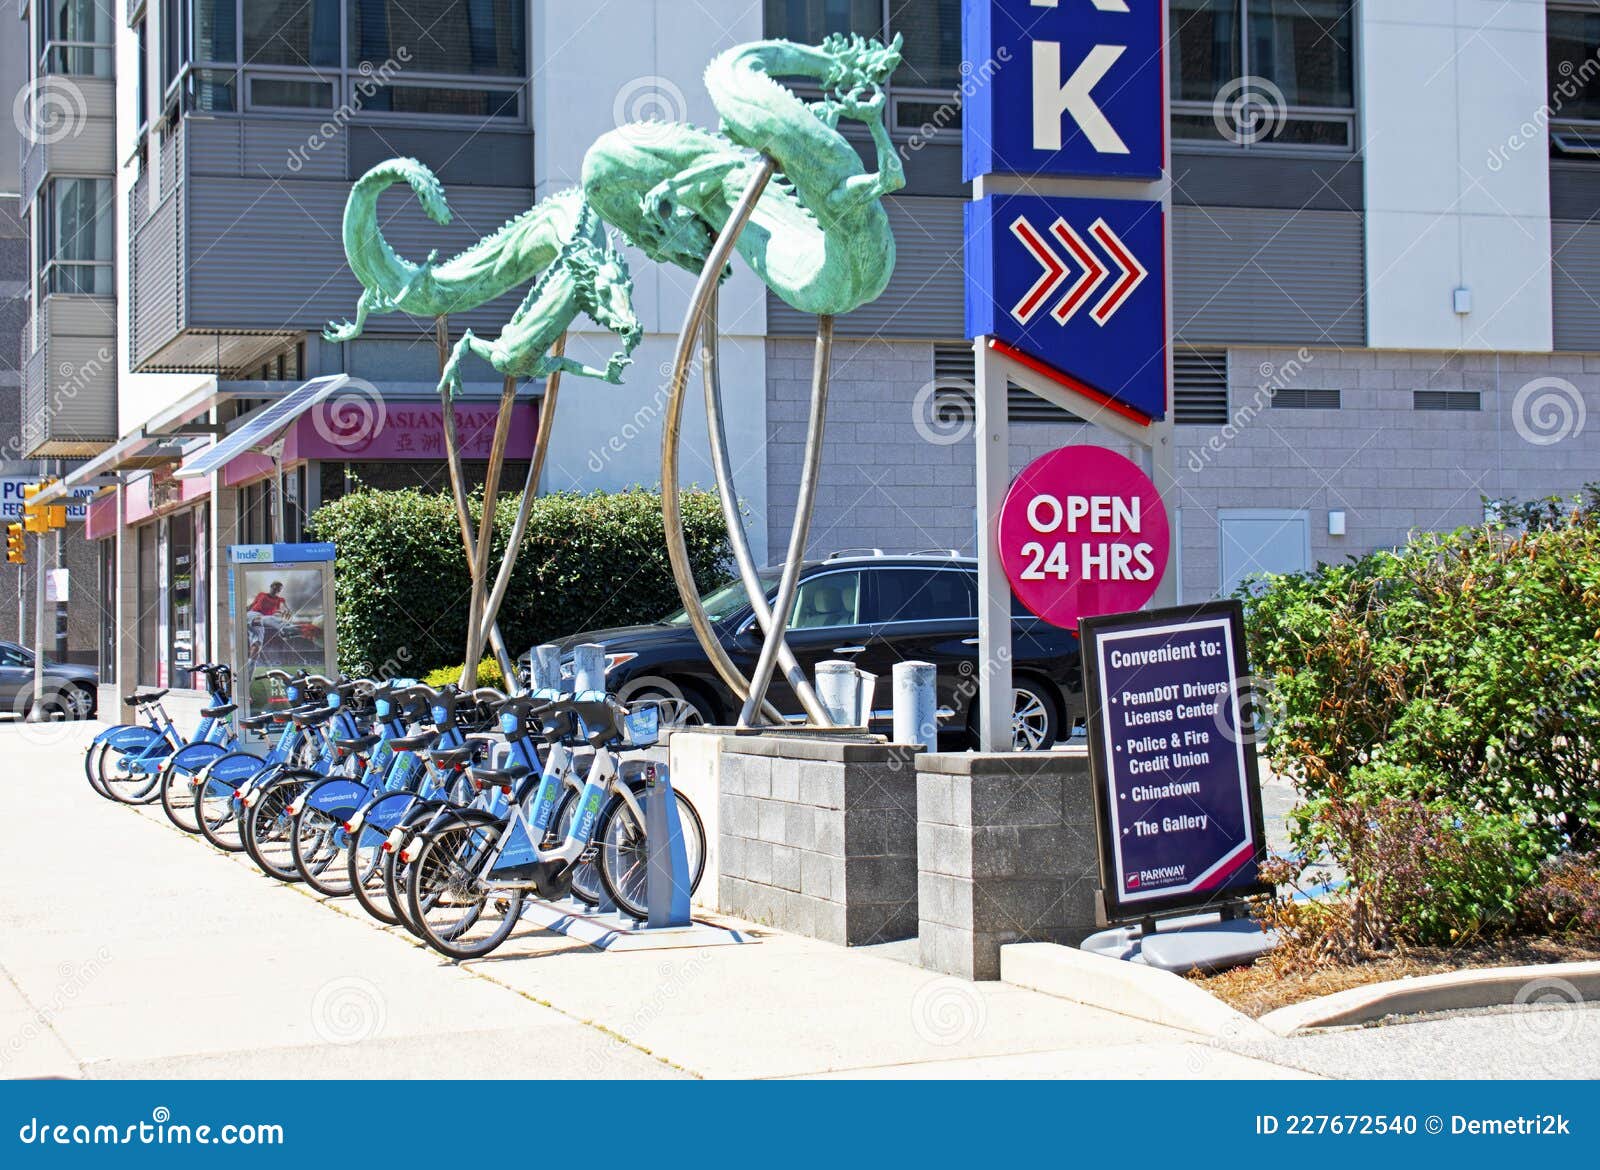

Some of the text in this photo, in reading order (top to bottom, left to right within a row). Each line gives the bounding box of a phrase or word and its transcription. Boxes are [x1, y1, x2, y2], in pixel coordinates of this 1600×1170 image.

[1030, 0, 1131, 154] K
[385, 411, 498, 428] ASIAN BAN
[1027, 494, 1141, 533] OPEN
[1020, 541, 1154, 581] 24 HRS
[1111, 640, 1221, 668] Convenient to:
[1122, 681, 1229, 706] PennDOT Drivers
[1124, 702, 1219, 727] License Center
[1127, 731, 1209, 754] Police & Fire
[1129, 751, 1209, 775] Credit Union
[1132, 781, 1200, 802] Chinatown
[1134, 814, 1207, 836] The Gallery
[1140, 865, 1185, 881] PARKWAY
